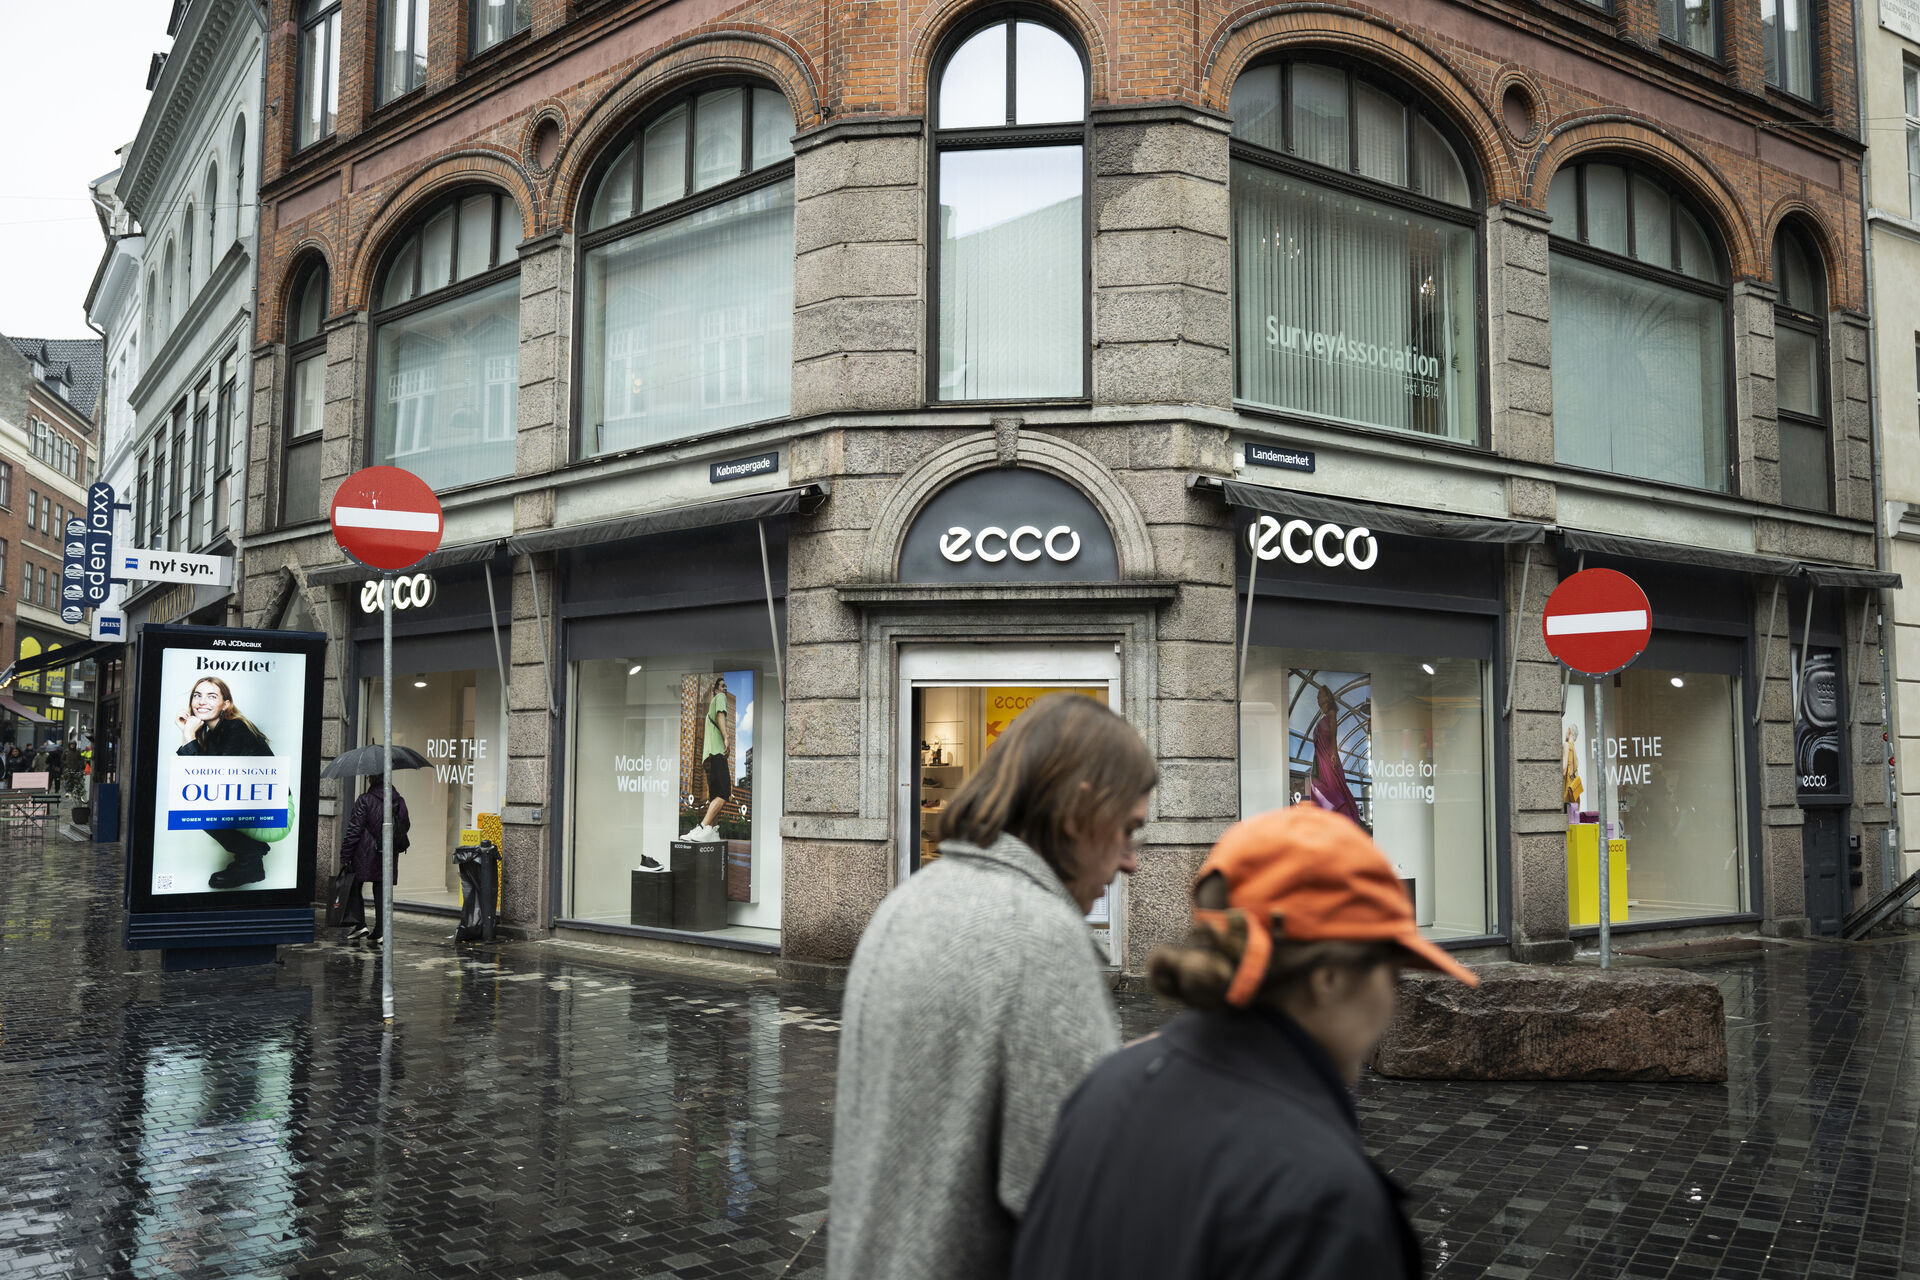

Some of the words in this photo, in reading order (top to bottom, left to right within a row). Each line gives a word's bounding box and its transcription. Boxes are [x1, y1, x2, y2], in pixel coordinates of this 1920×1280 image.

[1266, 315, 1439, 379] SurveyAssociation
[1404, 382, 1420, 396] est.
[1422, 384, 1439, 399] 1914
[1252, 447, 1310, 466] Landemærket
[716, 458, 771, 477] Købmagergade
[87, 487, 112, 536] jaxx
[939, 525, 1081, 563] ecco
[1249, 515, 1379, 571] ecco
[85, 542, 106, 600] eden
[149, 558, 177, 574] nyt
[180, 562, 214, 576] syn.
[212, 639, 227, 647] AFA
[228, 640, 262, 648] JCDecaux
[426, 739, 457, 759] RIDE
[460, 738, 487, 759] THE
[1631, 736, 1662, 757] THE
[184, 768, 226, 776] NORDIC
[228, 768, 278, 776] DESIGNER
[615, 754, 653, 771] Made
[656, 754, 672, 771] for
[1371, 759, 1415, 777] Made
[1418, 759, 1438, 777] for
[435, 764, 475, 785] WAVE
[1604, 763, 1652, 785] WAVE
[1802, 775, 1827, 787] ecco
[181, 783, 279, 802] OUTLET
[616, 775, 669, 797] Walking
[1373, 781, 1435, 804] Walking
[462, 834, 479, 843] ecco
